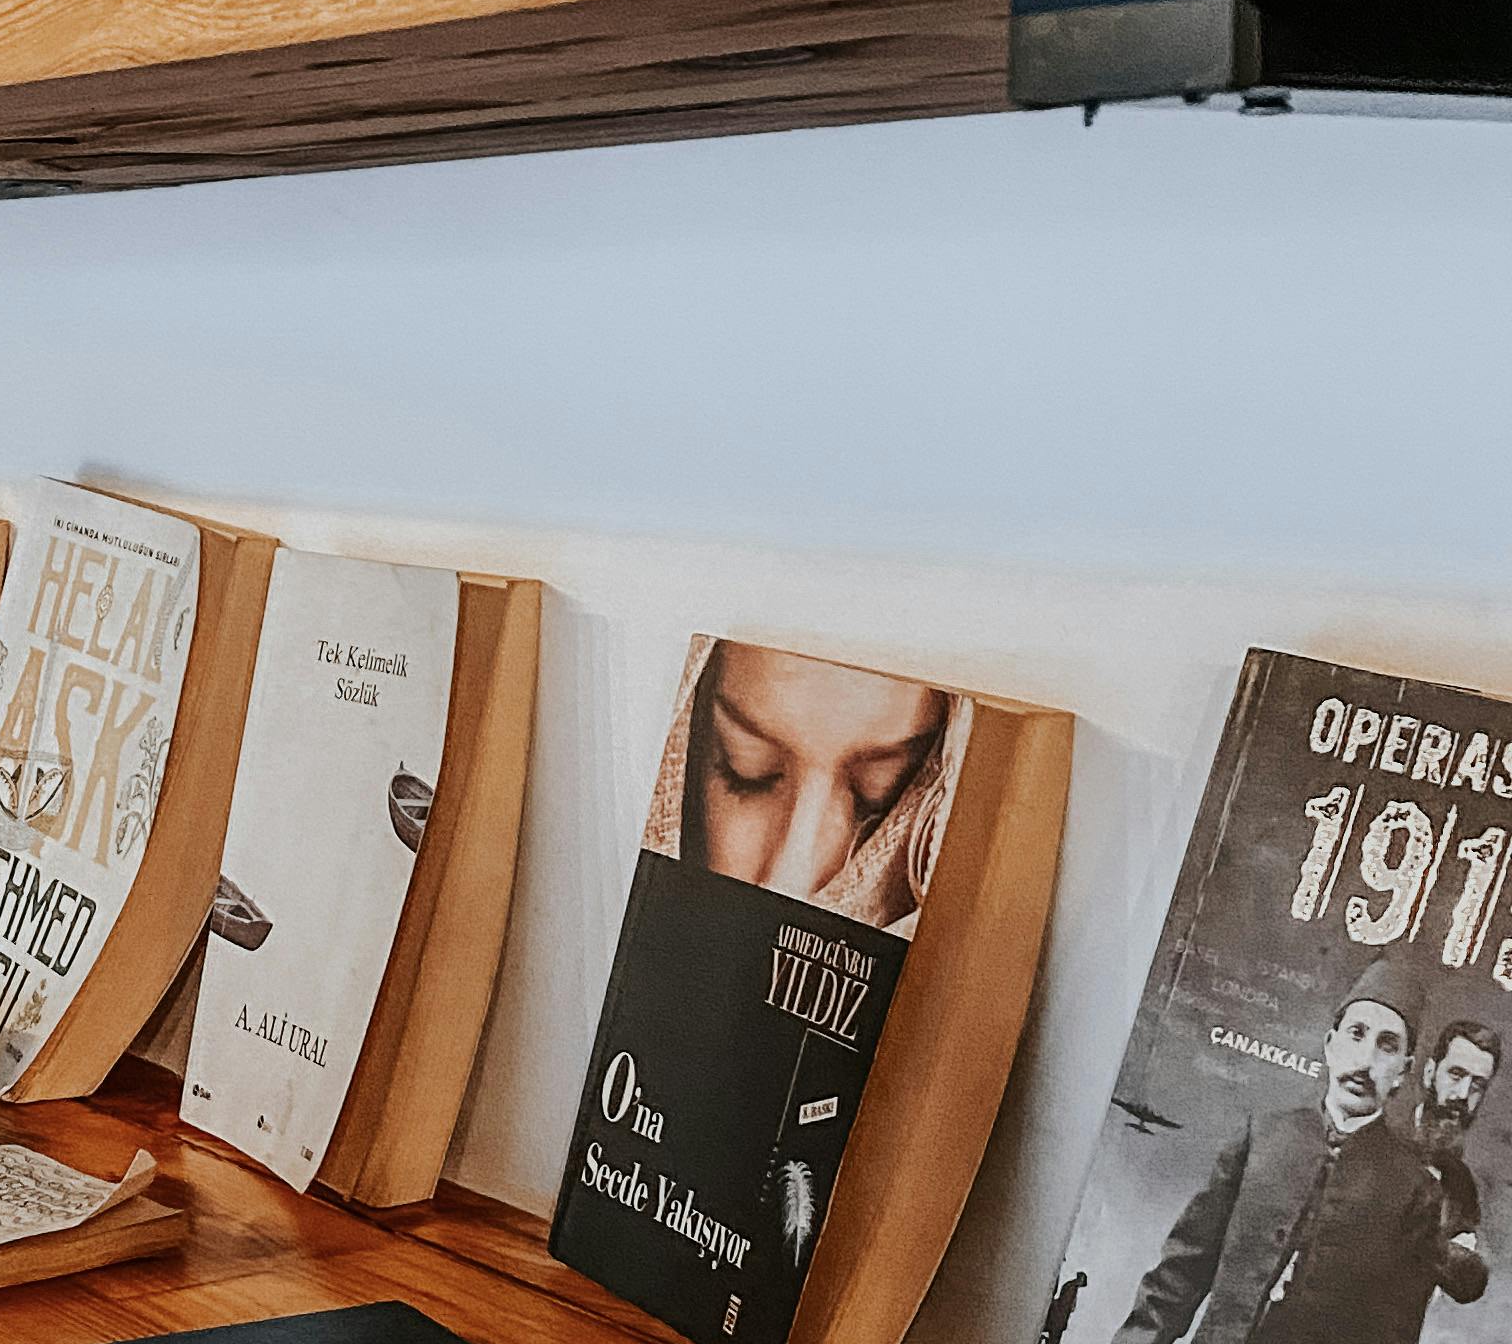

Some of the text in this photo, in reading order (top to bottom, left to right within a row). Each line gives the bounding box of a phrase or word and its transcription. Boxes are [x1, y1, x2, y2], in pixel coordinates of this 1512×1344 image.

[316, 639, 409, 679] Tek Kelimelik
[334, 676, 380, 709] Sözlük
[776, 923, 876, 983] AHMED GÜNBAY
[763, 947, 871, 1042] YILDIZ
[234, 1003, 329, 1068] A. ALİ URAL
[600, 1051, 665, 1145] O'na
[580, 1141, 752, 1272] Secde Yakışıyor
